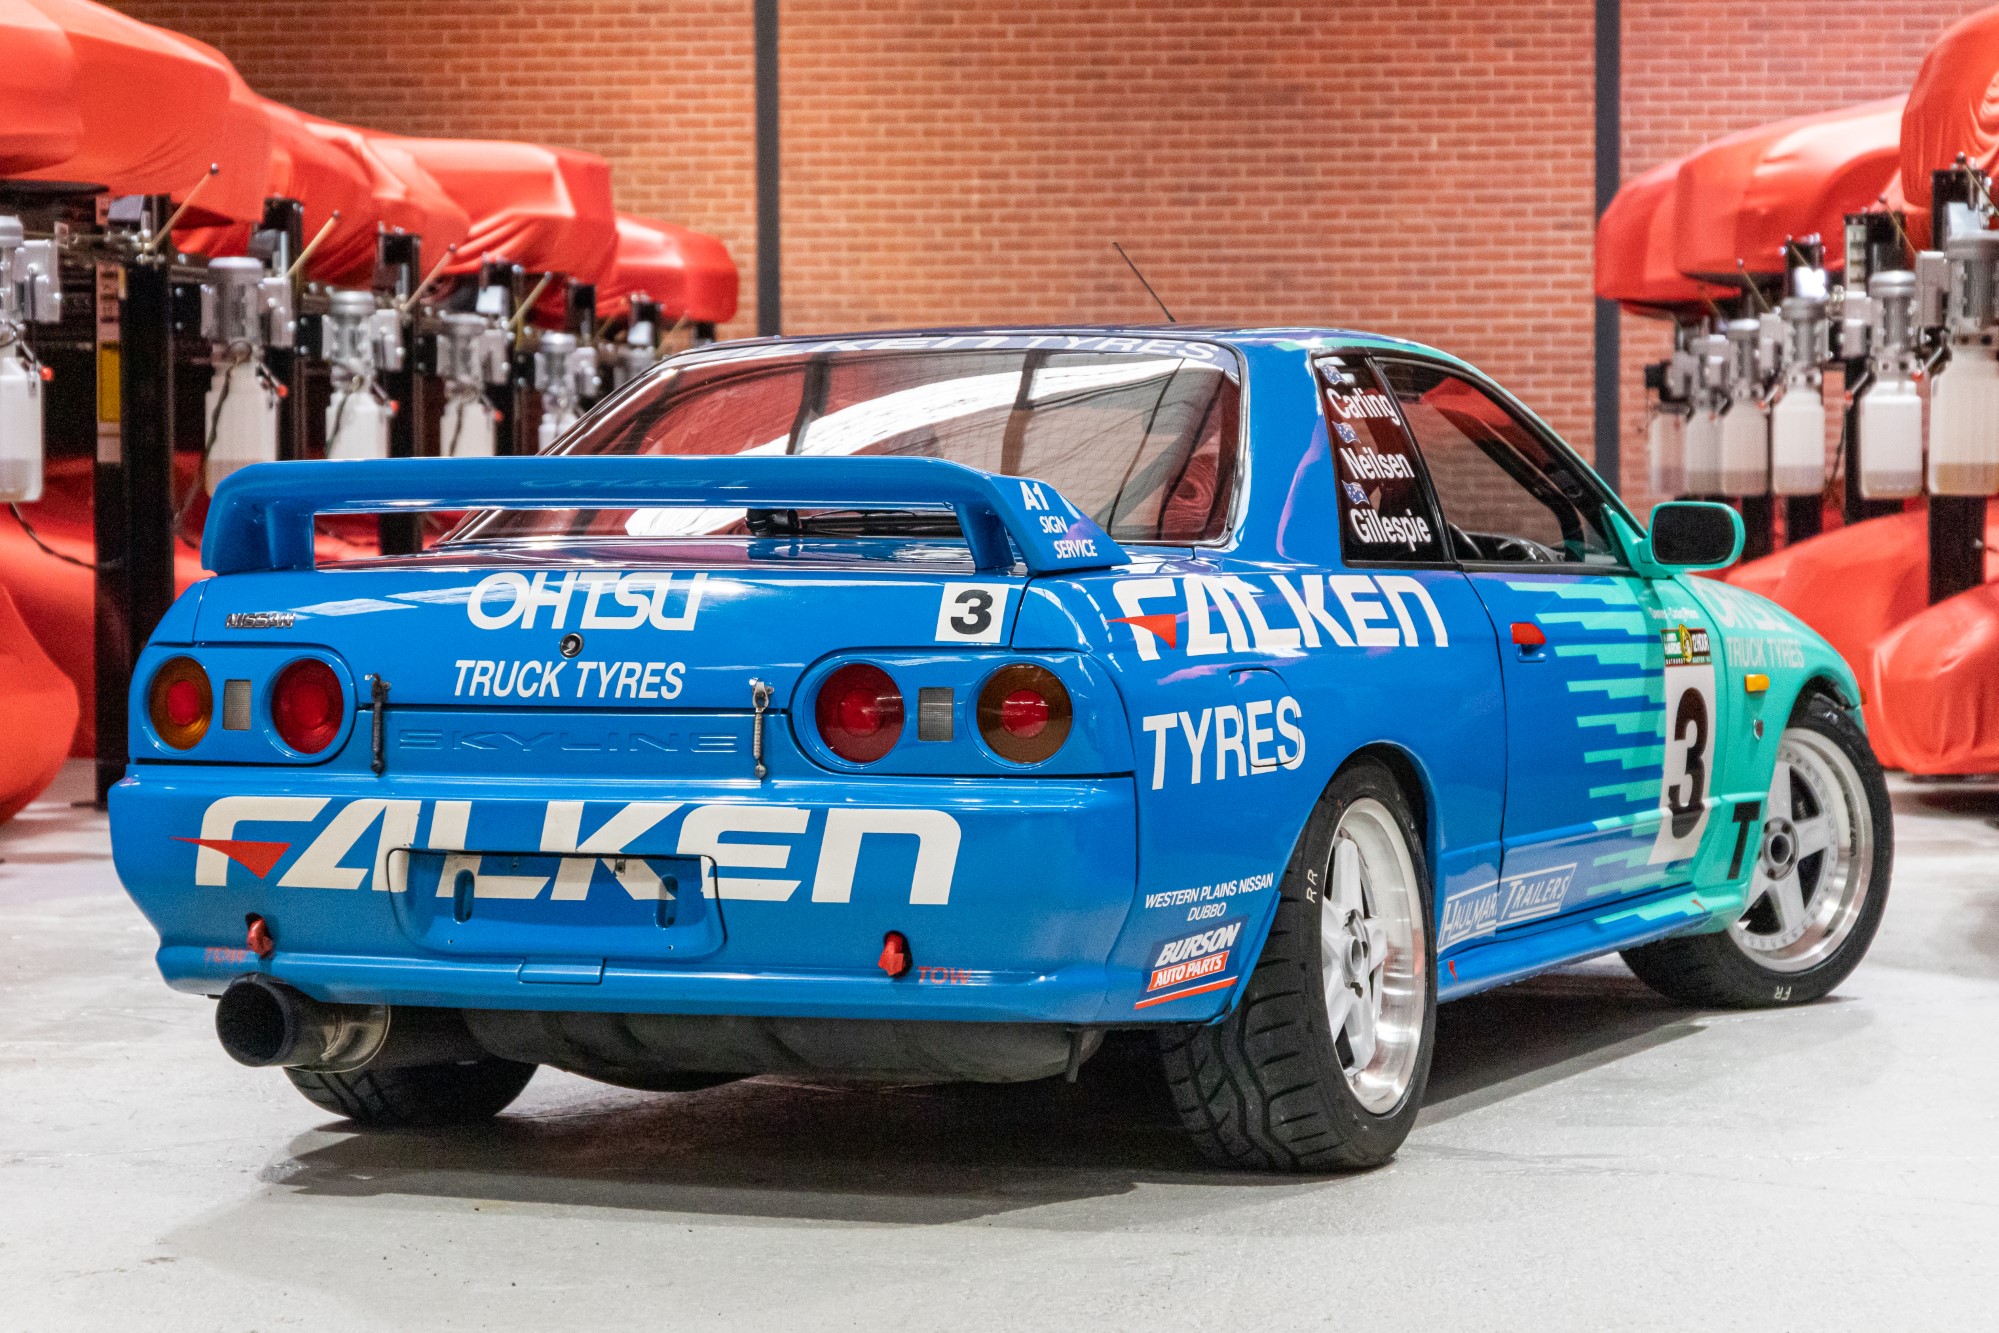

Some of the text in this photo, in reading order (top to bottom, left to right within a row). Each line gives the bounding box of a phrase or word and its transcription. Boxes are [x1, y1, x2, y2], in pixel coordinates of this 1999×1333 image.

[1017, 336, 1221, 360] TYRES
[1326, 387, 1401, 426] Carling
[1340, 447, 1415, 480] Neilsen
[1020, 481, 1050, 510] A1
[1039, 515, 1068, 534] SIGN
[1350, 508, 1432, 552] Gillespie
[1053, 539, 1098, 559] SERVICE
[467, 572, 708, 631] OHTSU
[950, 589, 994, 635] 3
[1113, 575, 1449, 661] FALKEN
[225, 612, 296, 629] NISSAN
[1725, 637, 1766, 668] TRUCK
[454, 660, 686, 699] TRUCK TYRES
[400, 729, 738, 753] SKYLINE
[1142, 696, 1306, 790] TYRES
[1668, 687, 1709, 840] 3
[195, 796, 962, 905] FALKEN
[1727, 801, 1762, 880] T
[1145, 872, 1274, 909] WESTERN PLAINS NISSAN
[1501, 876, 1569, 920] TRAILERS
[1186, 902, 1227, 922] DUBBO
[205, 946, 249, 963] TOW
[1154, 922, 1241, 968] BURSON
[917, 966, 974, 985] TOW
[1153, 954, 1223, 988] AUTO PARTS
